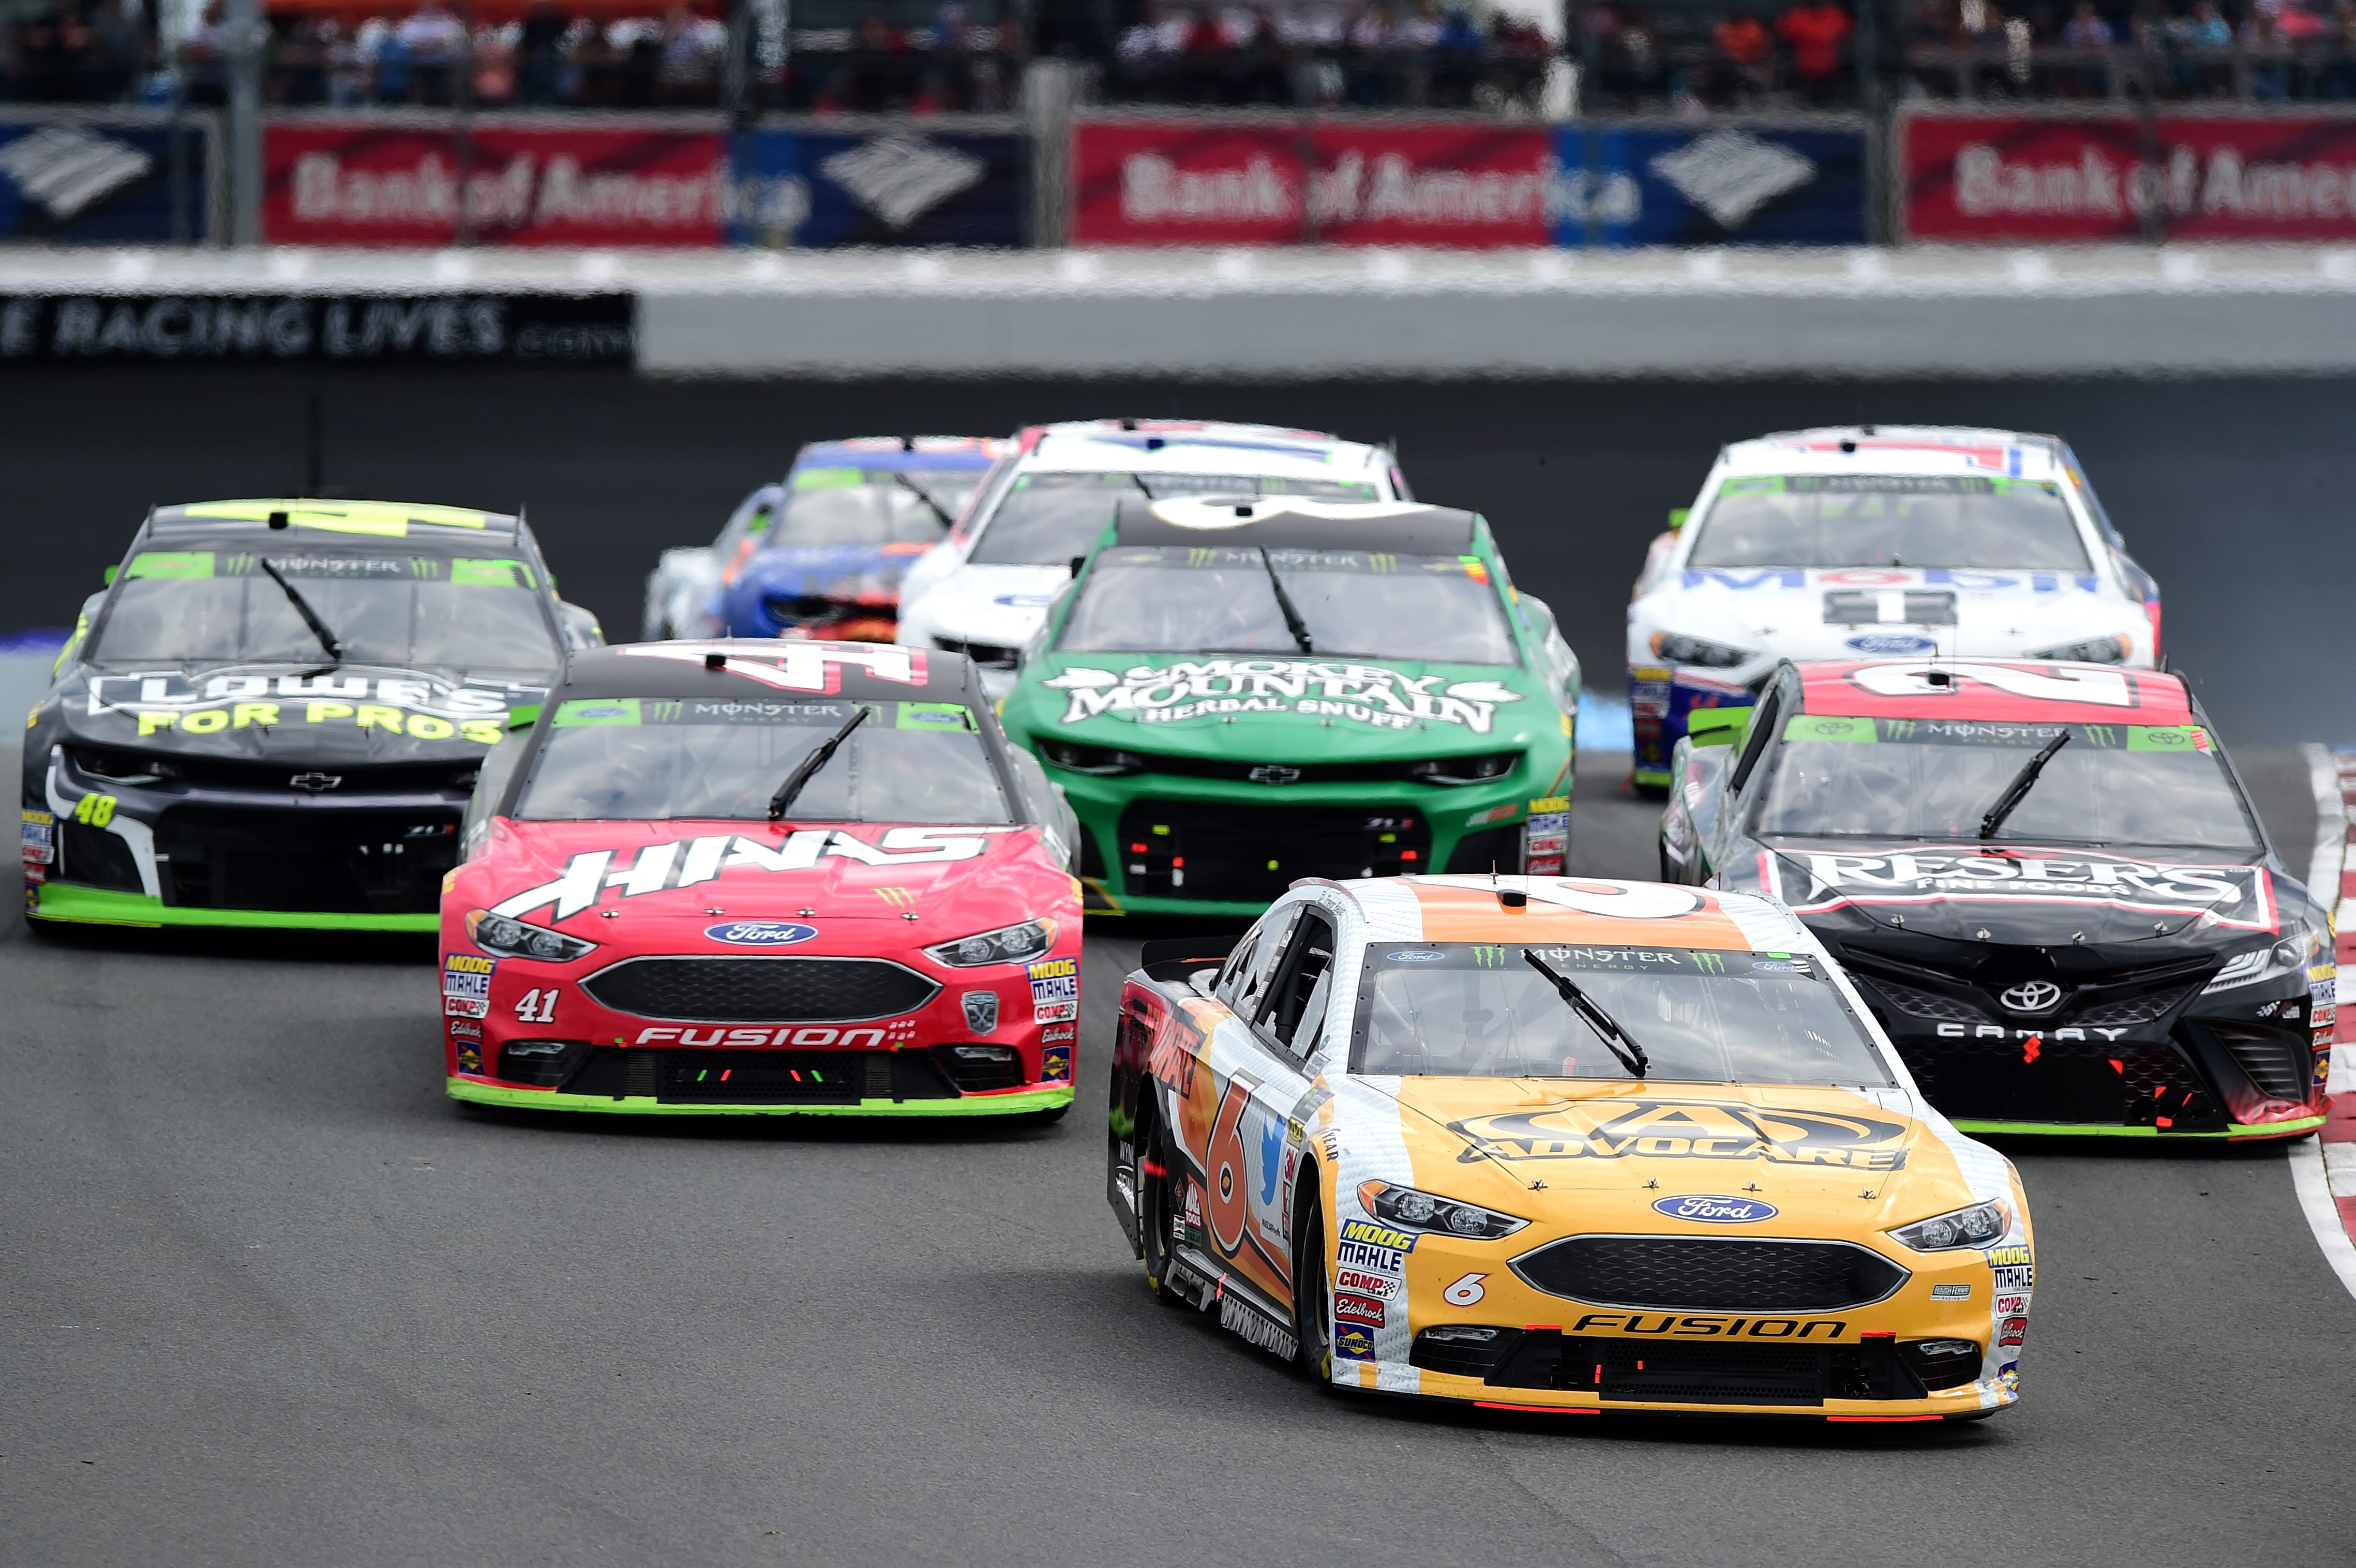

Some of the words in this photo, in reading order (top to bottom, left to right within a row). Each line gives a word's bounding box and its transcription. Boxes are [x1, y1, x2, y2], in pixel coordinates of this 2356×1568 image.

[291, 150, 462, 223] Bank
[1120, 151, 1299, 223] Bank
[1954, 144, 2123, 216] Bank
[54, 296, 314, 358] RACING
[325, 296, 510, 357] LIVES
[1125, 660, 1447, 696] SMOKEY
[695, 702, 842, 719] MONSTER
[1061, 674, 1495, 734] MOUNTAIN
[1144, 698, 1289, 722] HERBAL
[1296, 699, 1416, 730] SNUFF
[137, 703, 280, 736] FOR
[307, 702, 504, 745] PROS
[74, 792, 118, 828] 48
[1917, 876, 1995, 890] FINE
[2015, 881, 2132, 896] FOODS
[725, 923, 797, 942] Ford
[445, 955, 496, 974] MOOG
[1398, 952, 1434, 960] Ford
[1519, 948, 1682, 965] MONSTER
[1561, 962, 1649, 971] ENERGY
[1028, 958, 1075, 980] MOOG
[445, 974, 488, 994] MAHLE
[1032, 978, 1075, 1000] MAHLE
[514, 988, 560, 1023] 41
[635, 1027, 886, 1047] FUSION
[1937, 1022, 2129, 1042] CAMRY
[1464, 1136, 1903, 1170] ADVOCARE
[1206, 1073, 1252, 1260] 6
[1185, 1210, 1200, 1227] TOOLS
[1677, 1197, 1753, 1219] Ford
[1343, 1221, 1416, 1250] MOOG
[1337, 1242, 1403, 1272] MAHLE
[1988, 1246, 2030, 1266] MOOG
[1339, 1271, 1384, 1290] COMP
[1994, 1268, 2032, 1288] MAHLE
[1367, 1288, 1389, 1297] CAMS
[1442, 1272, 1494, 1308] 6
[1934, 1285, 1952, 1295] ROUSH
[1336, 1299, 1383, 1321] Edelbrock
[1572, 1314, 1848, 1338] FUSION
[1337, 1336, 1374, 1351] SUNOCO
